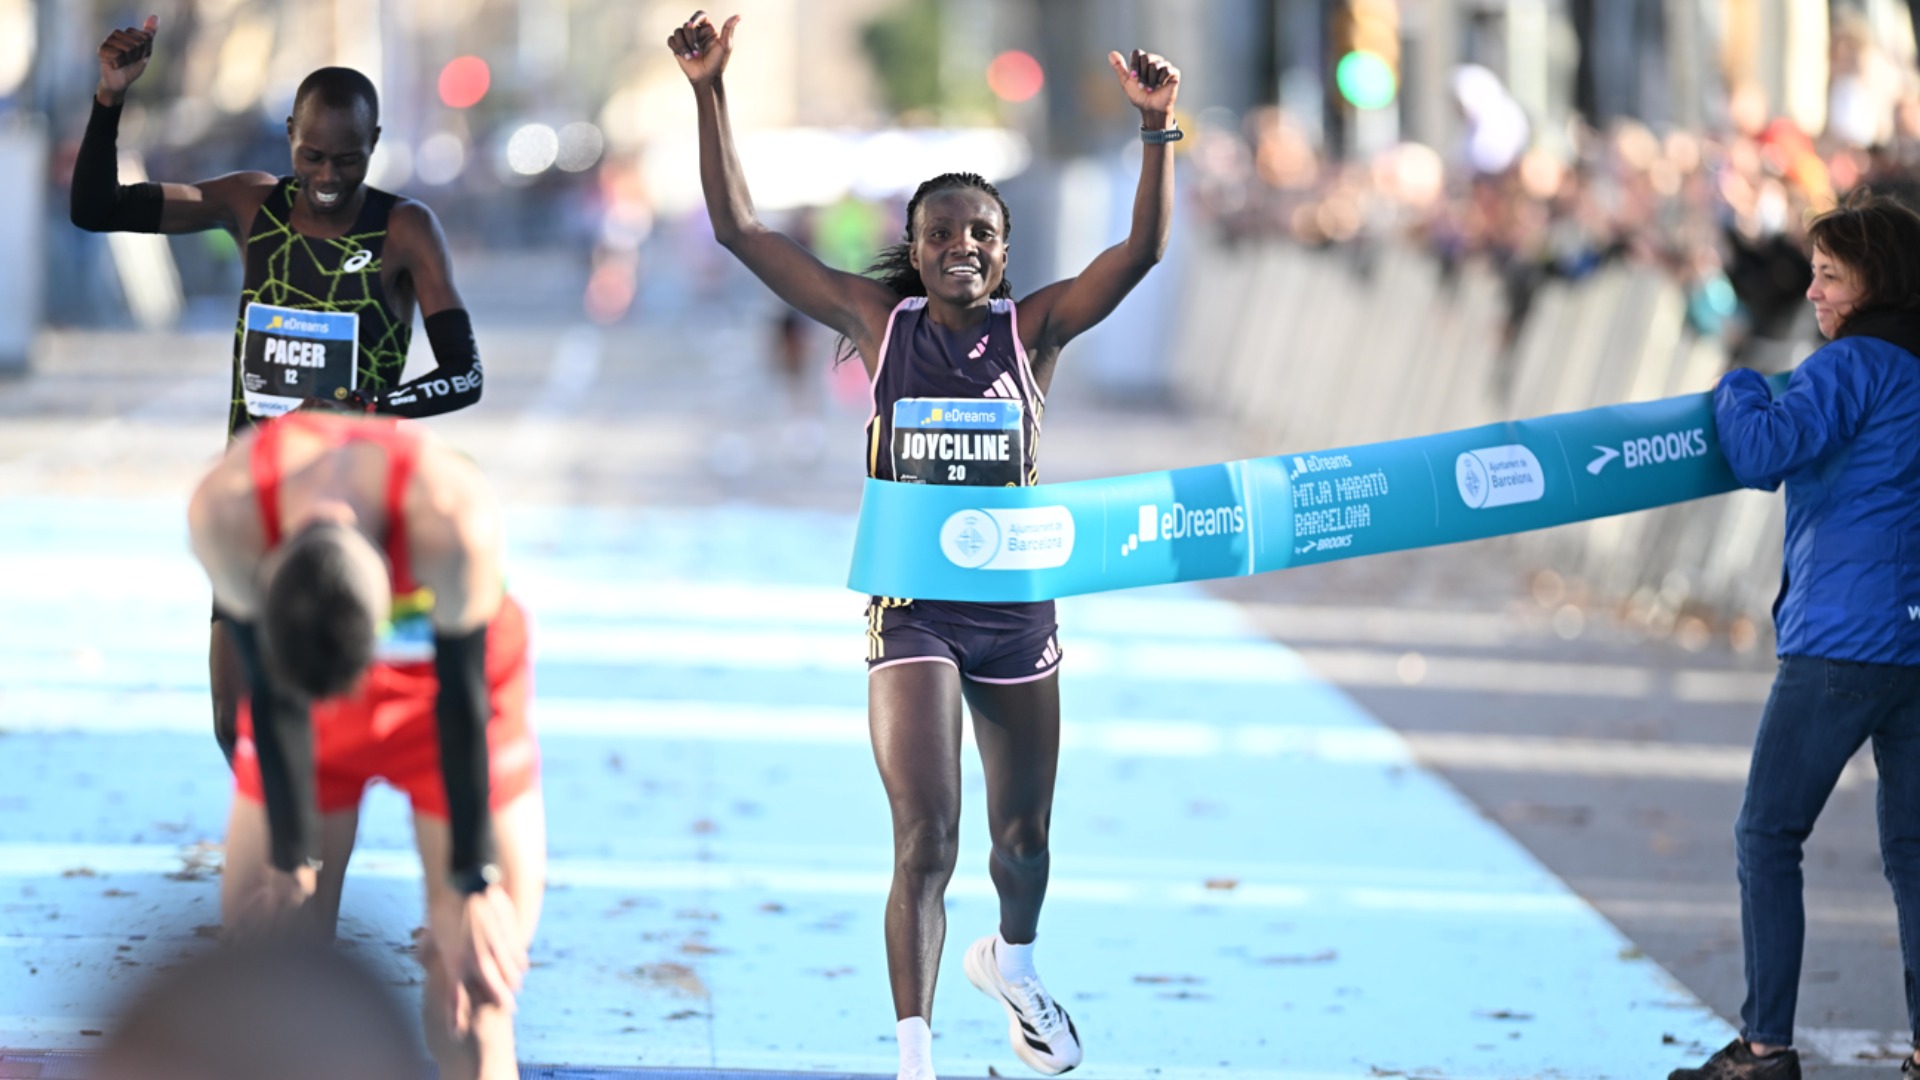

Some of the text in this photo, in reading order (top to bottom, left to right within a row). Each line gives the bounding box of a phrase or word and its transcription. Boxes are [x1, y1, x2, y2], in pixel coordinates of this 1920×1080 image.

[283, 318, 329, 333] eDreams
[264, 338, 327, 368] PACER
[285, 369, 298, 384] 12
[416, 379, 450, 398] TO
[944, 409, 996, 423] eDreams
[902, 433, 1010, 461] JOYCILINE
[1622, 428, 1708, 469] BROOKS
[1307, 454, 1352, 472] eDreams
[948, 465, 966, 481] 20
[1491, 472, 1533, 488] Barcelona
[1292, 467, 1389, 508] MITJA MARATÓ
[1161, 502, 1244, 540] eDreams
[1294, 503, 1370, 537] BARCELONA
[1008, 537, 1062, 552] Barcelona
[1317, 534, 1353, 551] BROOKS
